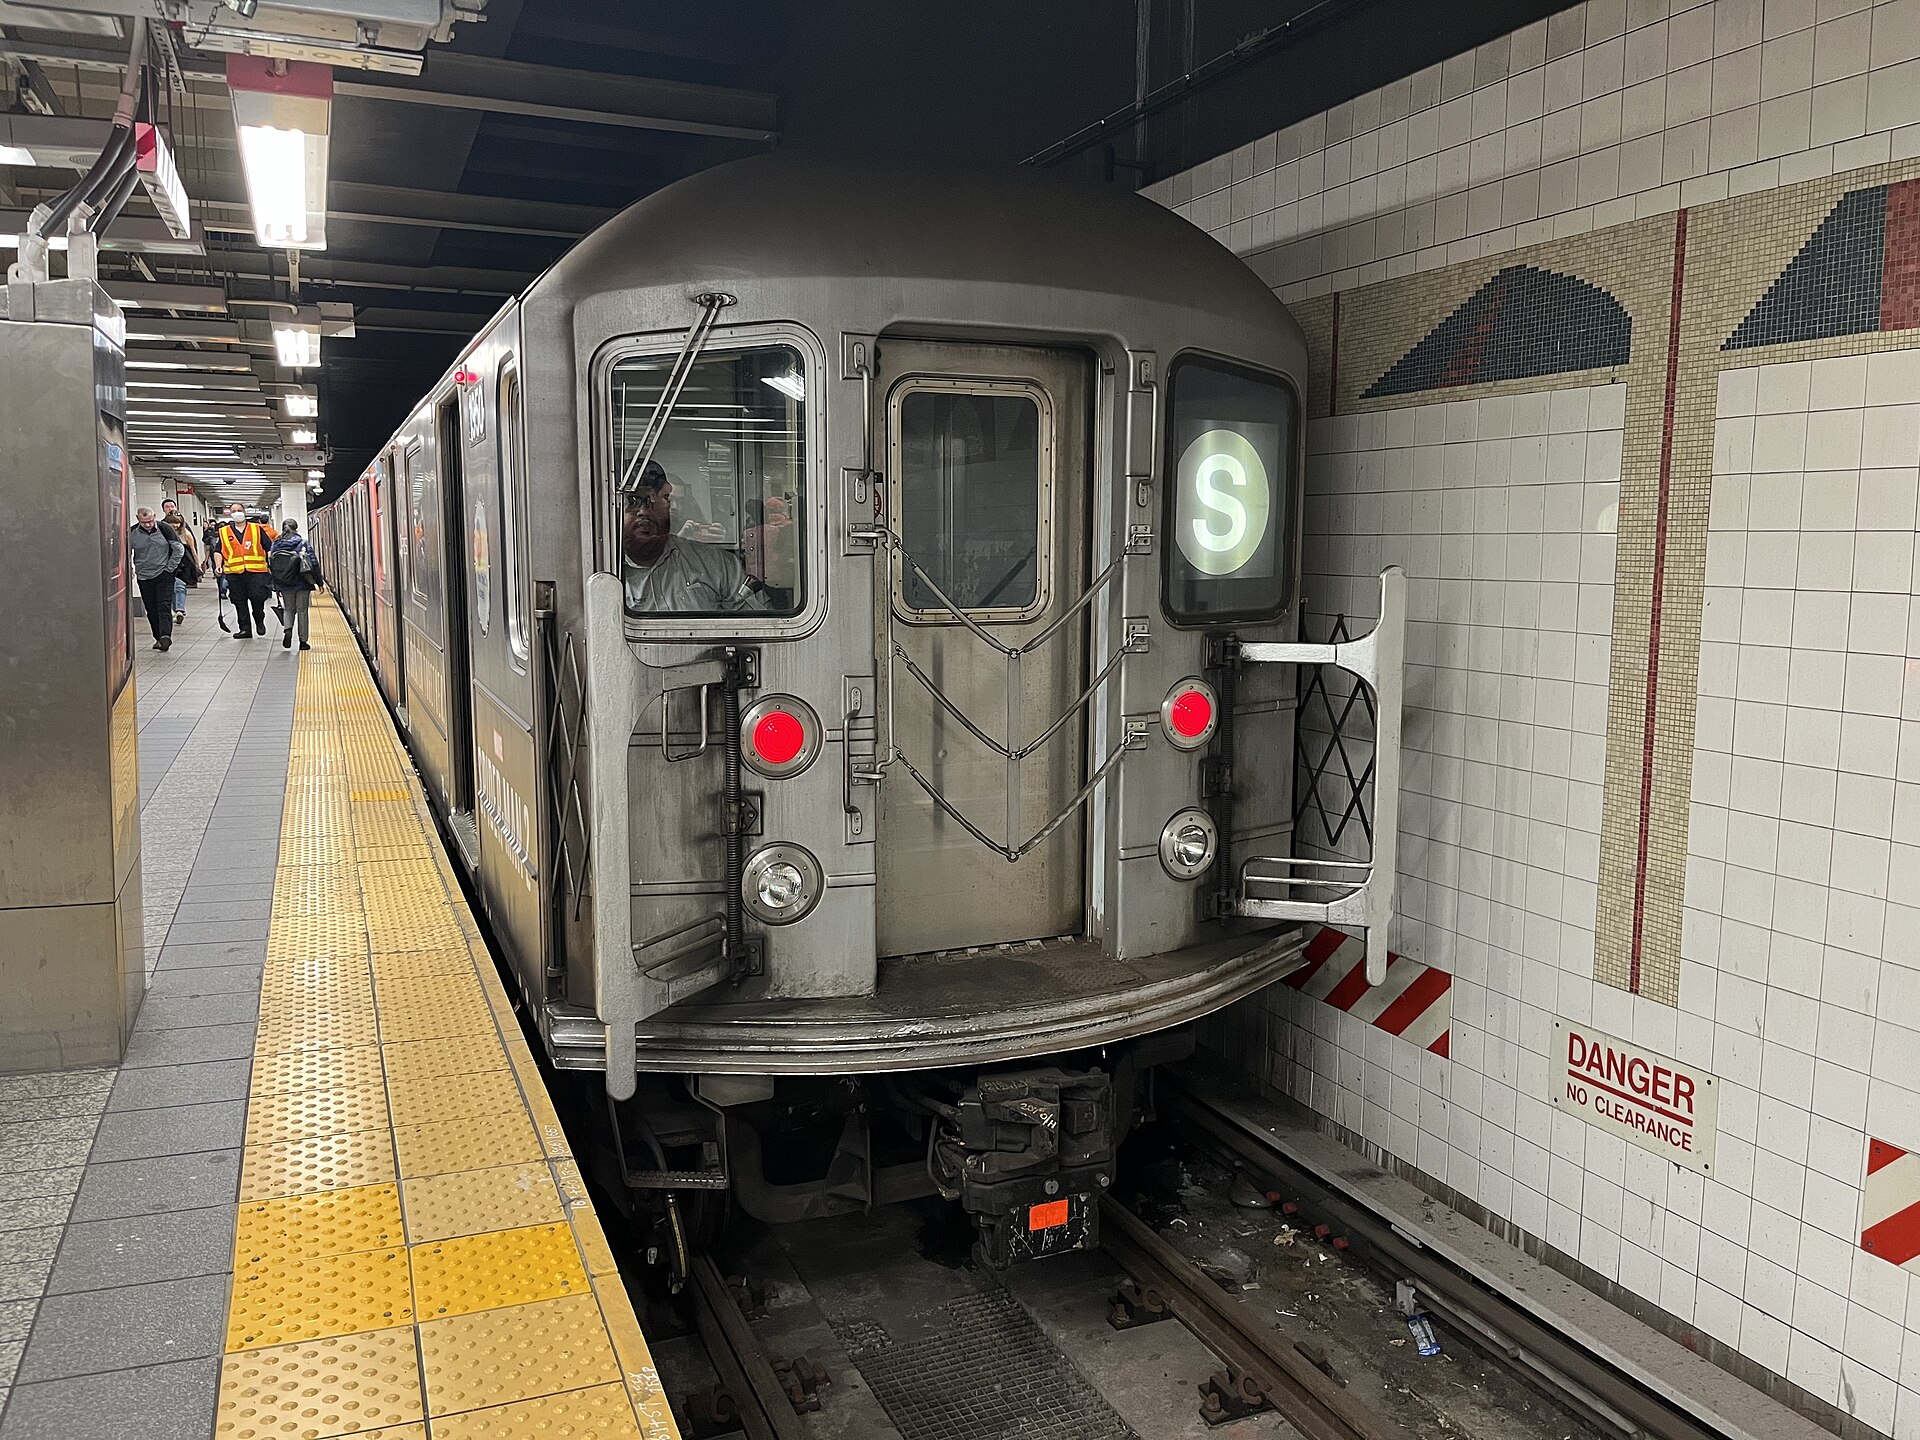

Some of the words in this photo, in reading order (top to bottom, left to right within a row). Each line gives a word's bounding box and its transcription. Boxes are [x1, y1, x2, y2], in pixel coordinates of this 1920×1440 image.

[1192, 453, 1247, 552] S
[1567, 1031, 1695, 1115] DANGER
[1566, 1082, 1588, 1106] NO
[1594, 1095, 1693, 1153] CLEARANCE
